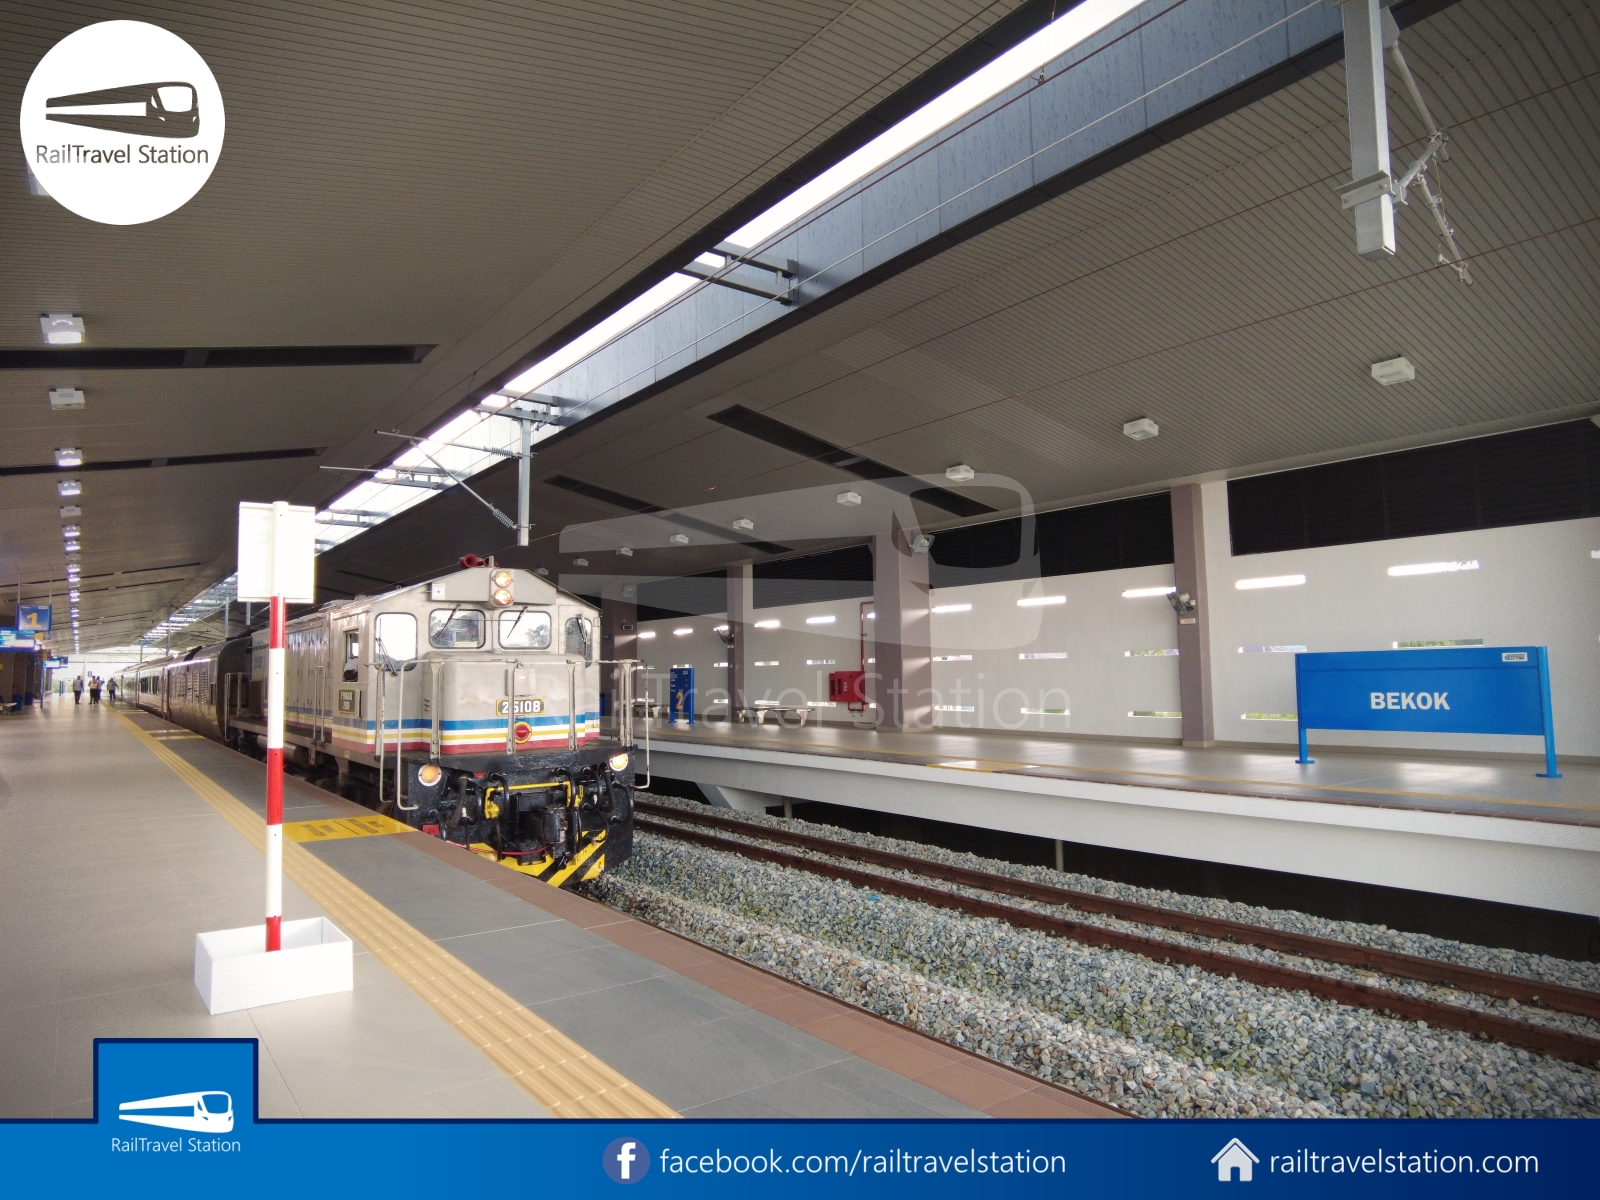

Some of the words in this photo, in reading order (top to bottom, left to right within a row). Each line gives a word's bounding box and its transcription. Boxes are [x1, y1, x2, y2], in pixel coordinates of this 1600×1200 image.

[26, 612, 42, 629] 1
[501, 700, 541, 714] 25108
[675, 691, 684, 710] 2
[1370, 692, 1451, 710] BEKOK
